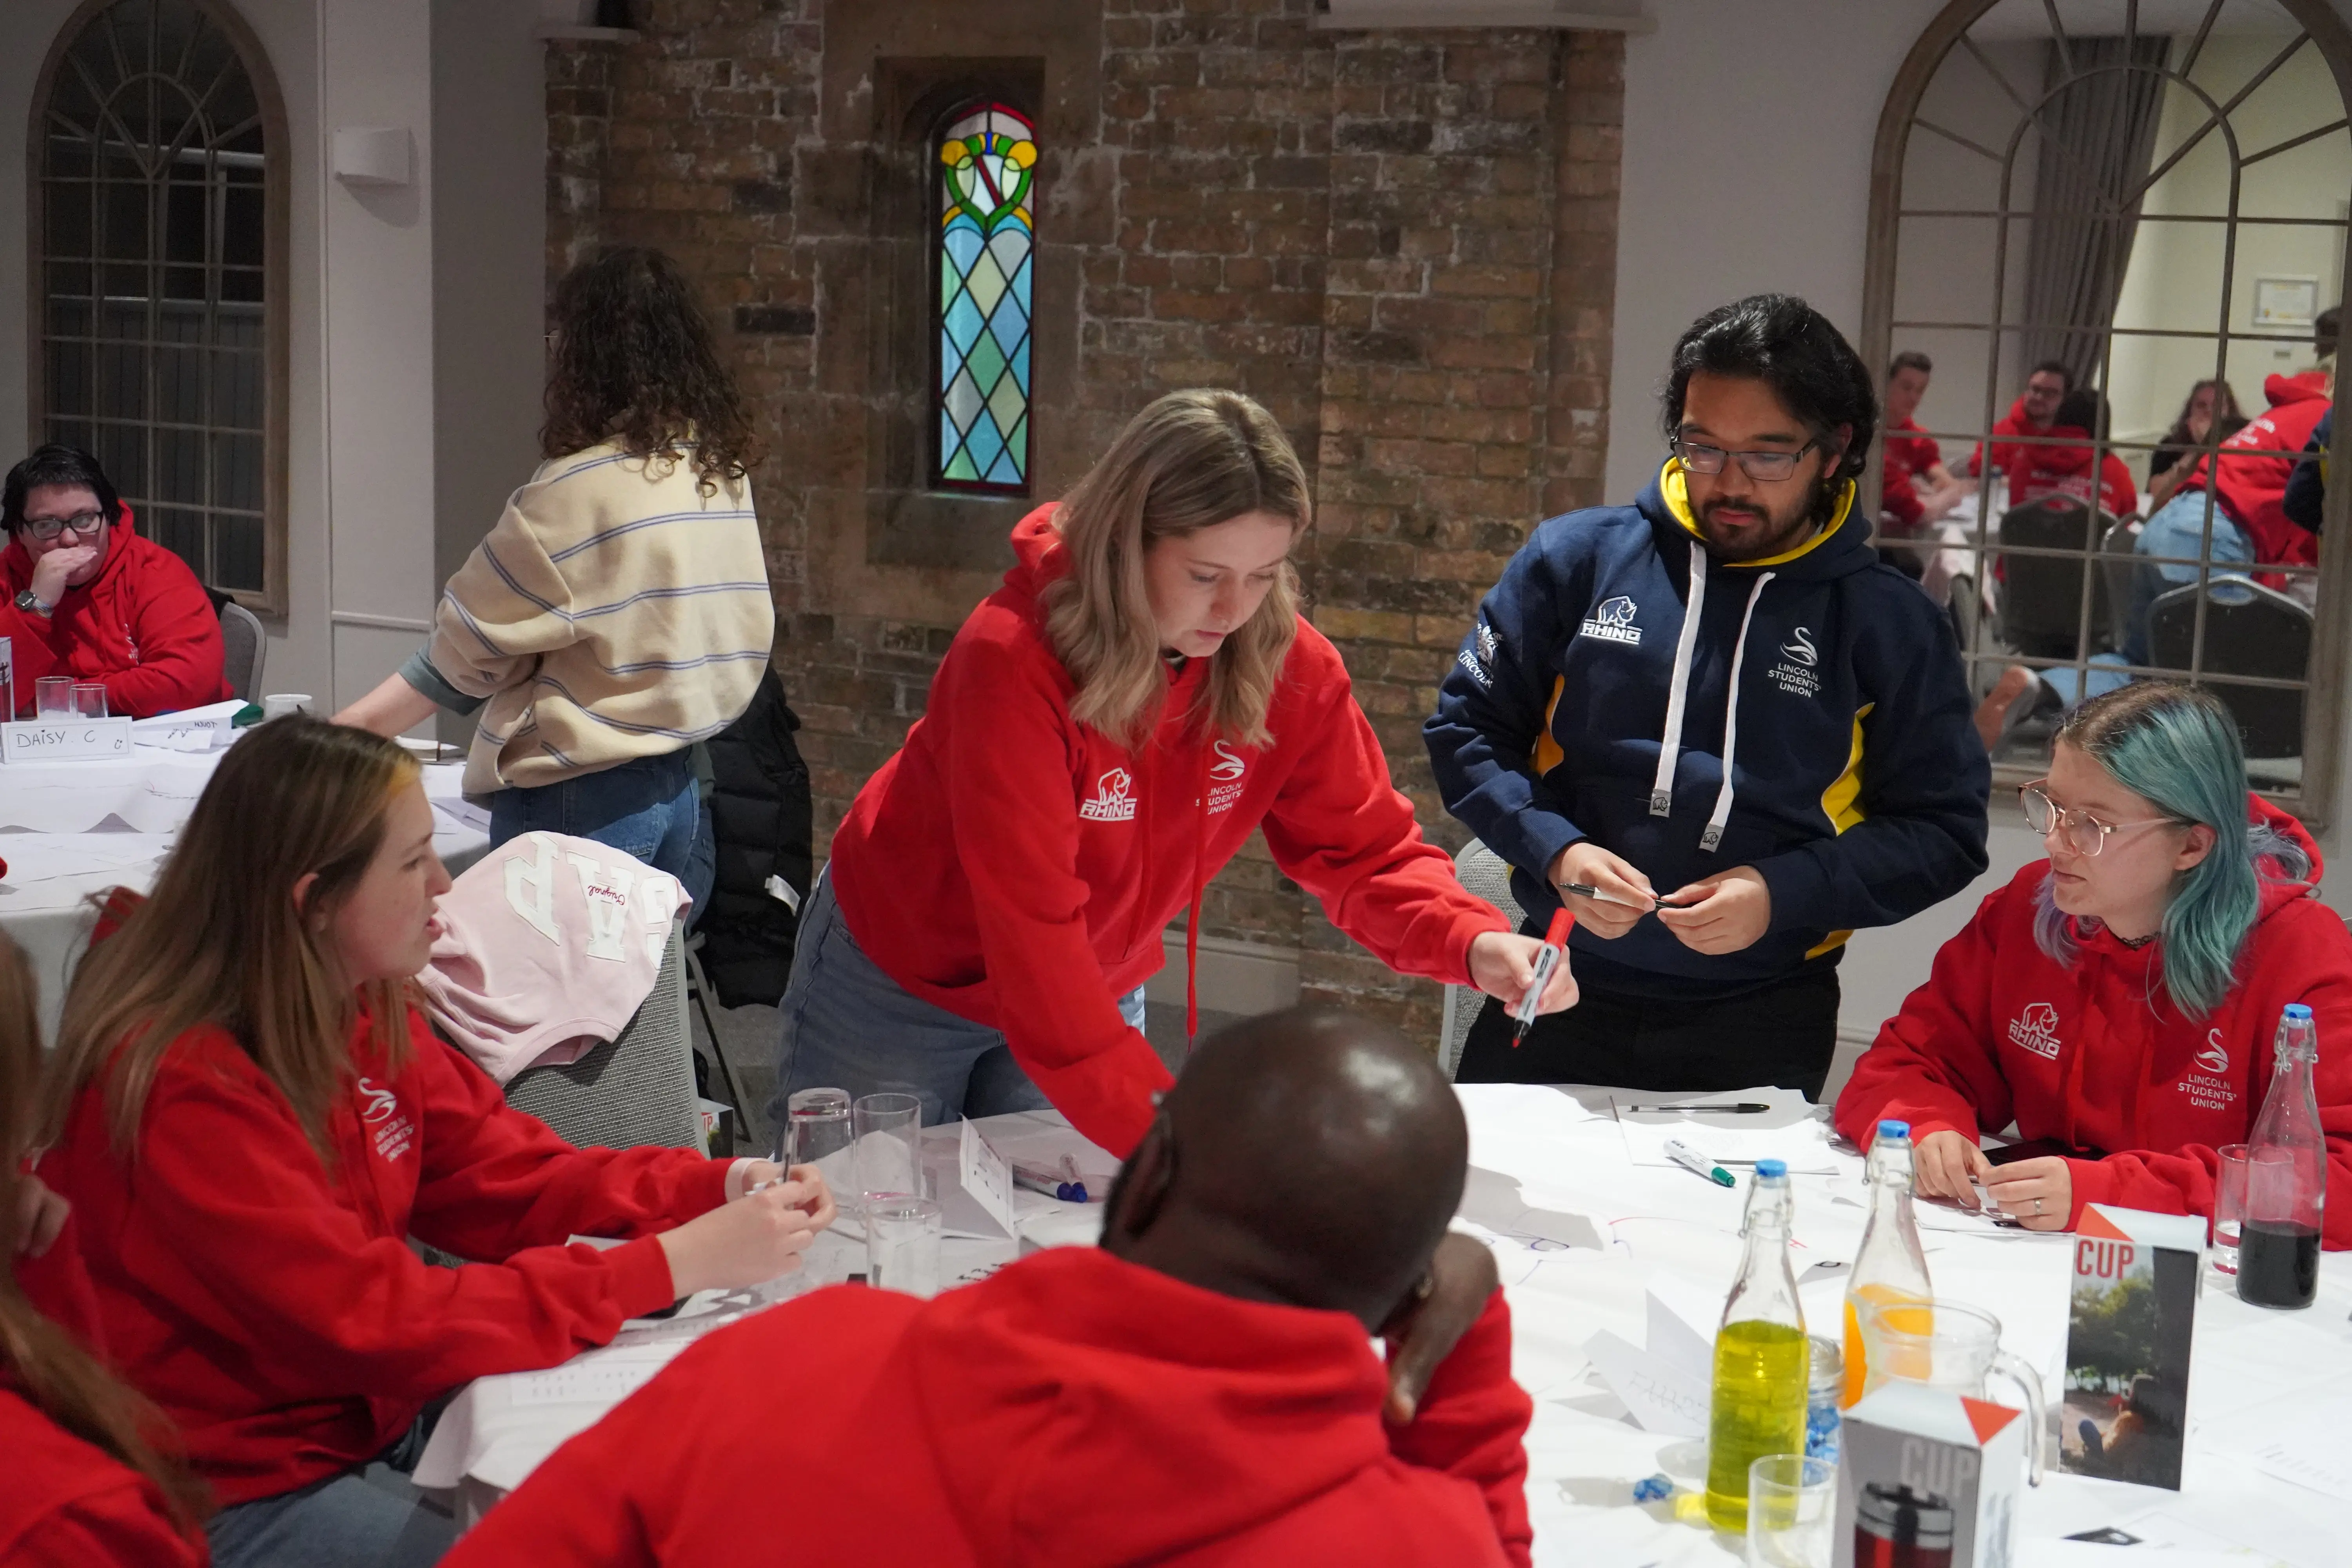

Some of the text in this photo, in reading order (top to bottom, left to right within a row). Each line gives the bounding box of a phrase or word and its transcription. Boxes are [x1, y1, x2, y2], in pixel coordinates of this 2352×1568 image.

[1582, 622, 1641, 642] RHINO
[1458, 652, 1493, 689] LINCOLN
[1768, 669, 1822, 691] STUDENTS'
[1778, 662, 1818, 682] LINCOLN
[1779, 682, 1812, 698] UNION
[84, 730, 96, 742] C
[1195, 789, 1243, 806] SUDENTS'
[1207, 782, 1242, 796] INCOLN
[1080, 802, 1136, 817] RHINO
[588, 885, 625, 906] Original
[2009, 1023, 2060, 1056] RHINO
[2188, 1073, 2230, 1090] LINCOLN
[2178, 1082, 2237, 1101] STUDENTS'
[2190, 1096, 2225, 1111] UNION
[2076, 1239, 2134, 1279] CUP
[1900, 1437, 1977, 1499] CUP
